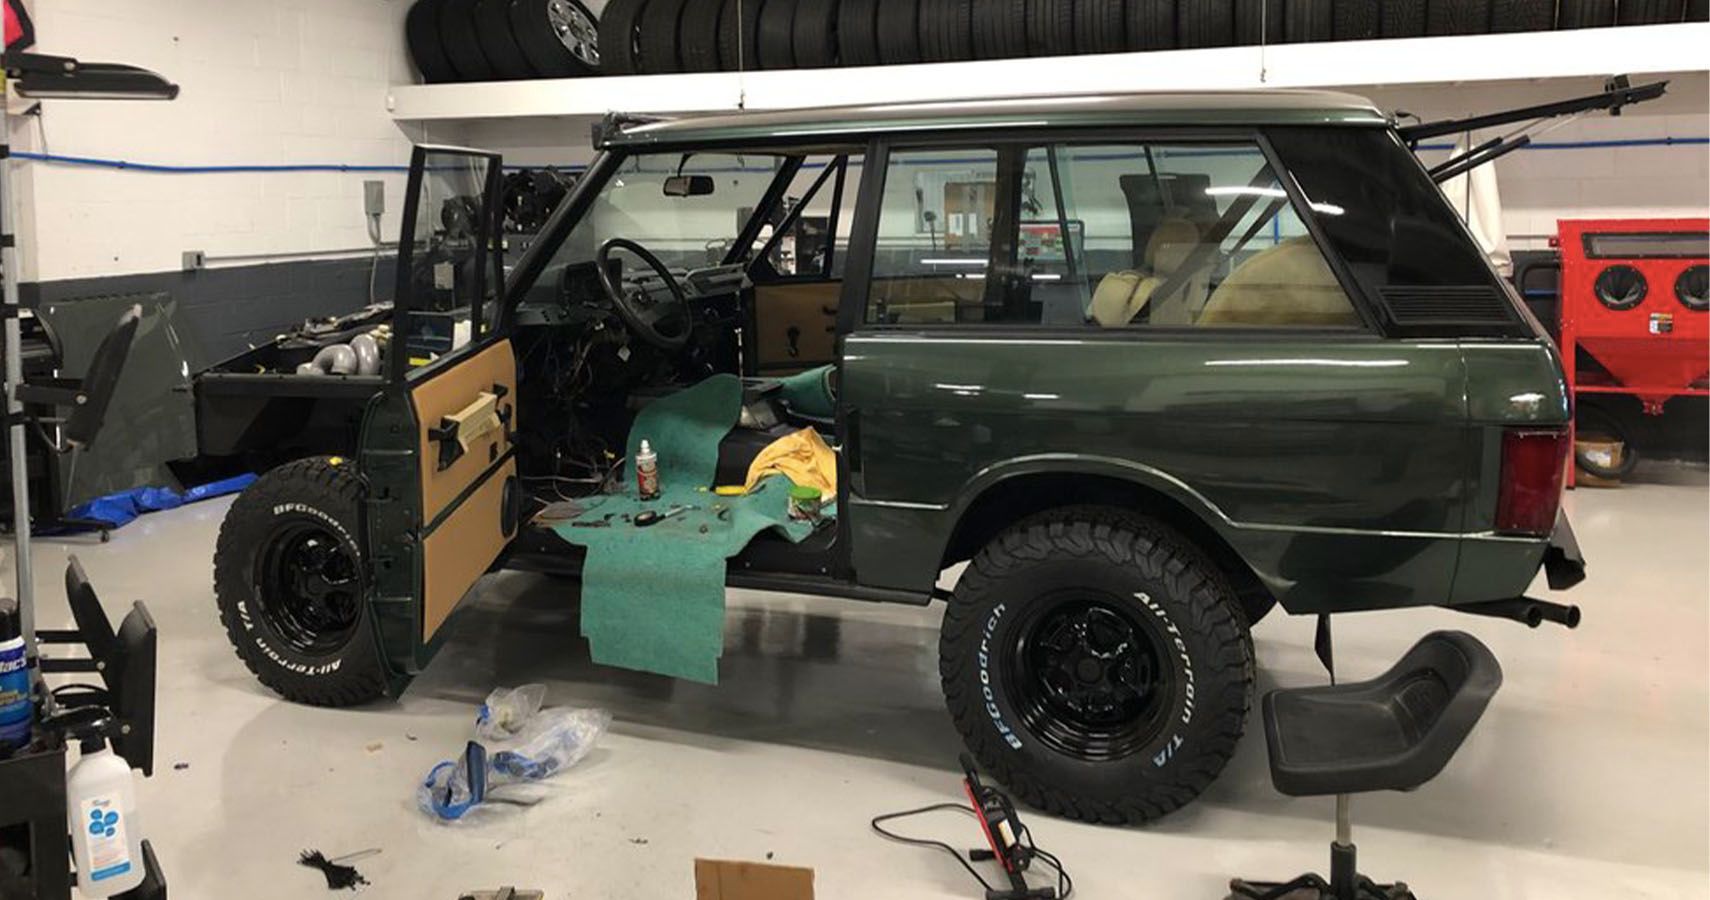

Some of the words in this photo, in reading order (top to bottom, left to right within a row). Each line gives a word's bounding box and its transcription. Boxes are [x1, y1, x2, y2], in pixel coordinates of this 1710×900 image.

[237, 601, 254, 631] T/A
[256, 637, 342, 676] All-Terrain
[1133, 592, 1195, 724] All-Terrain
[978, 603, 1023, 750] BFGoodrich
[1153, 733, 1184, 768] T/A
